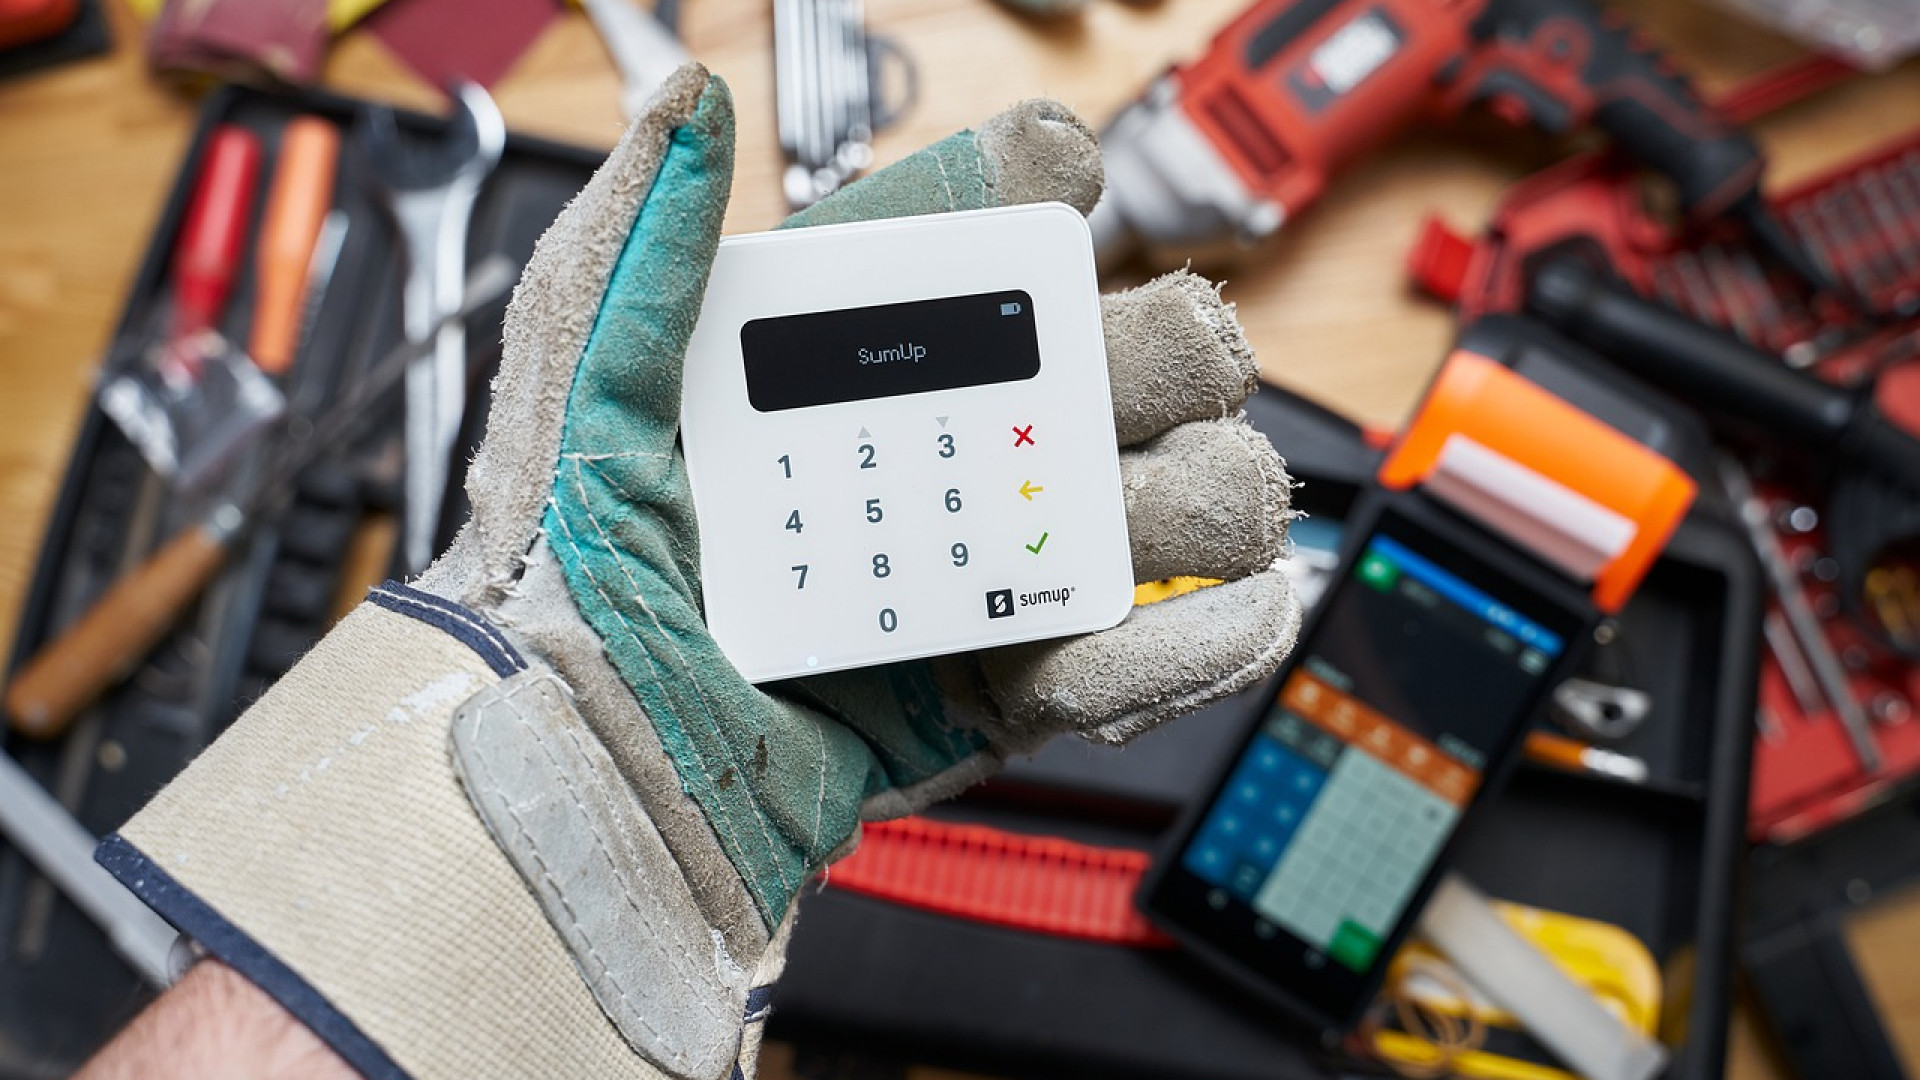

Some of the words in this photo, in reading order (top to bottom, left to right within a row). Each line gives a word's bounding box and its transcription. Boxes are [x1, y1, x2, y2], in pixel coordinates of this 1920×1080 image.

[857, 341, 927, 366] SumUp
[777, 454, 792, 479] 1
[857, 443, 877, 470] 2
[937, 434, 956, 459] 3
[785, 509, 804, 534] 4
[866, 498, 883, 524] 5
[944, 488, 963, 514] 6
[791, 564, 809, 590] 7
[872, 553, 892, 579] 8
[950, 542, 969, 568] 9
[878, 608, 898, 633] 0
